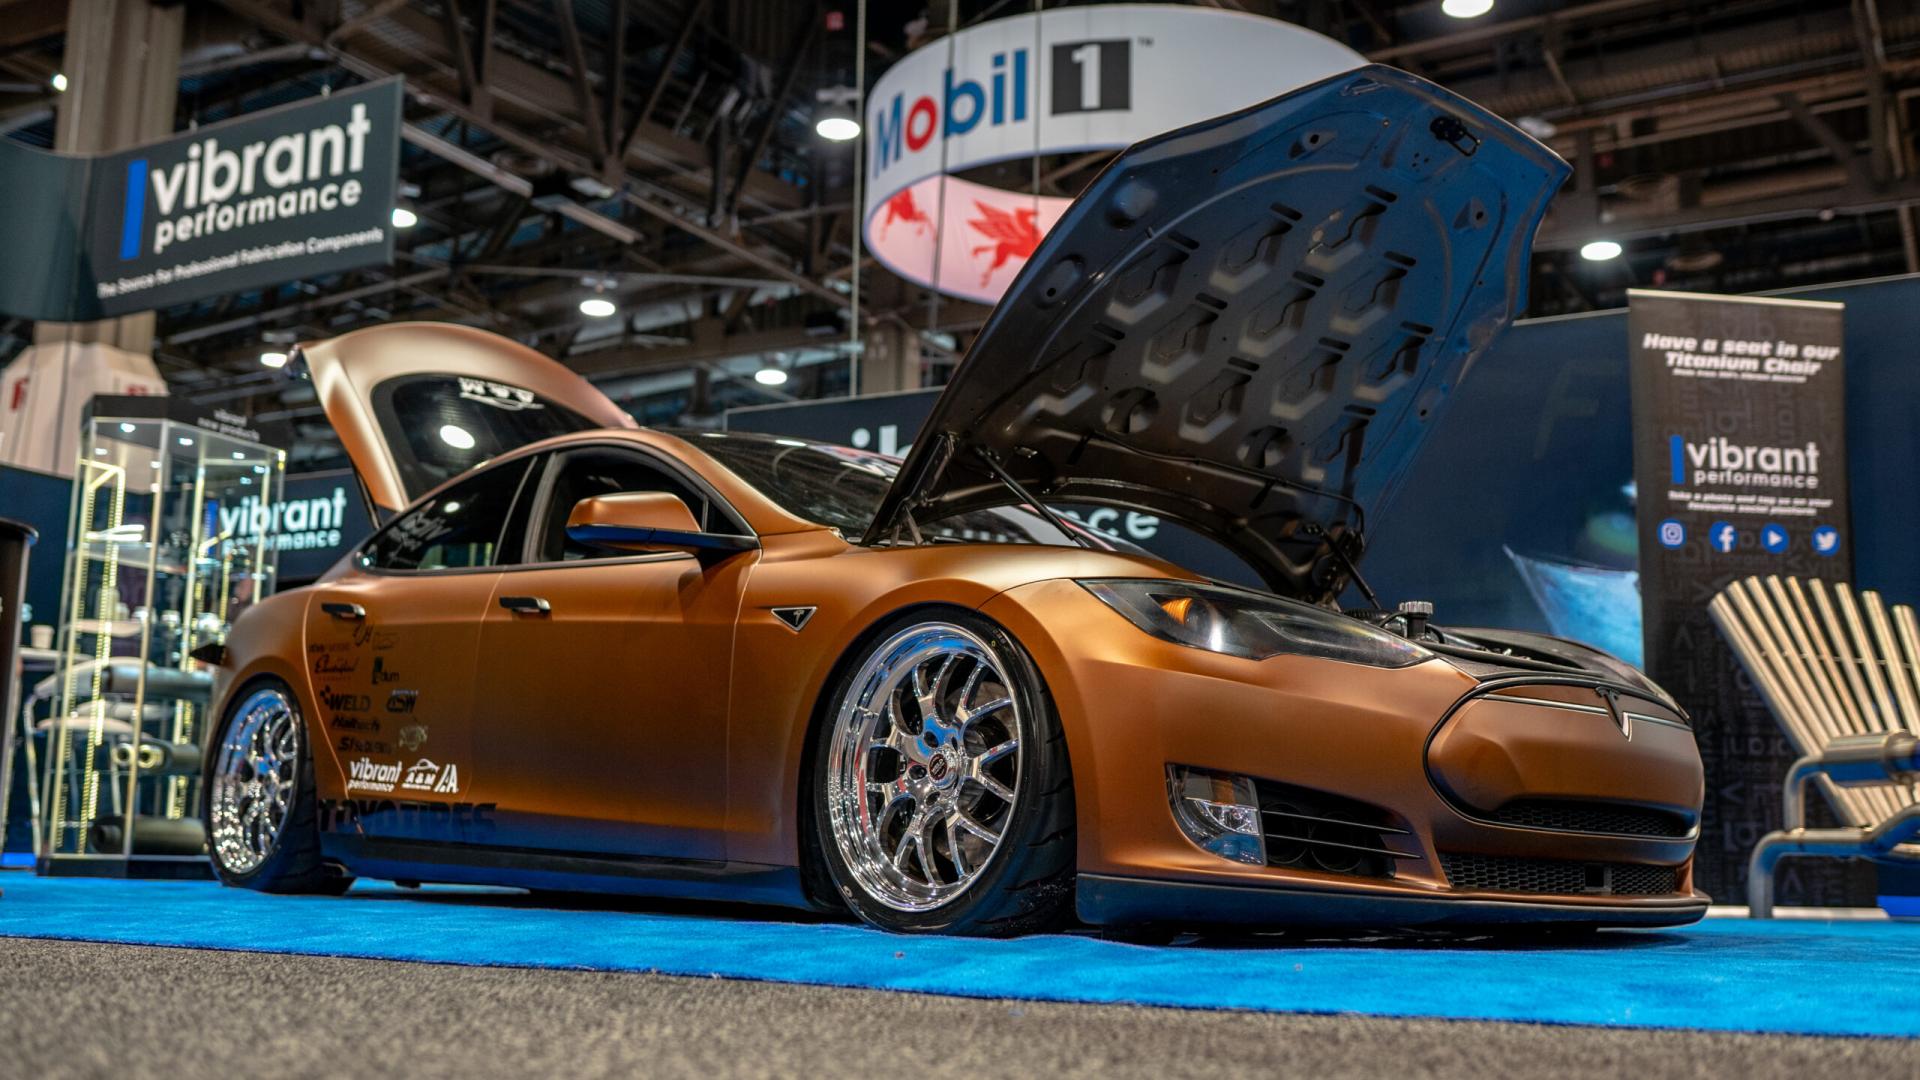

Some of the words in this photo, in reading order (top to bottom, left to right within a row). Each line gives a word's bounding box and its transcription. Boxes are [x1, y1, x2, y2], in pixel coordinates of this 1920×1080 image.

[873, 48, 1027, 180] Mobil
[1071, 43, 1102, 111] 1
[151, 103, 371, 215] vibrant
[154, 179, 362, 254] performance
[306, 226, 384, 254] Components
[1643, 333, 1697, 351] Have
[1702, 338, 1717, 352] a
[1722, 338, 1771, 356] seat
[1776, 341, 1798, 359] in
[1802, 344, 1840, 361] our
[1665, 351, 1759, 372] Titanium
[1763, 354, 1822, 376] Chair
[1686, 437, 1820, 474] vibrant
[1694, 468, 1819, 488] performance
[219, 487, 347, 536] vibrant
[221, 529, 341, 556] permance
[329, 695, 371, 712] WELD
[349, 756, 402, 784] vibrant
[347, 779, 395, 793] performance
